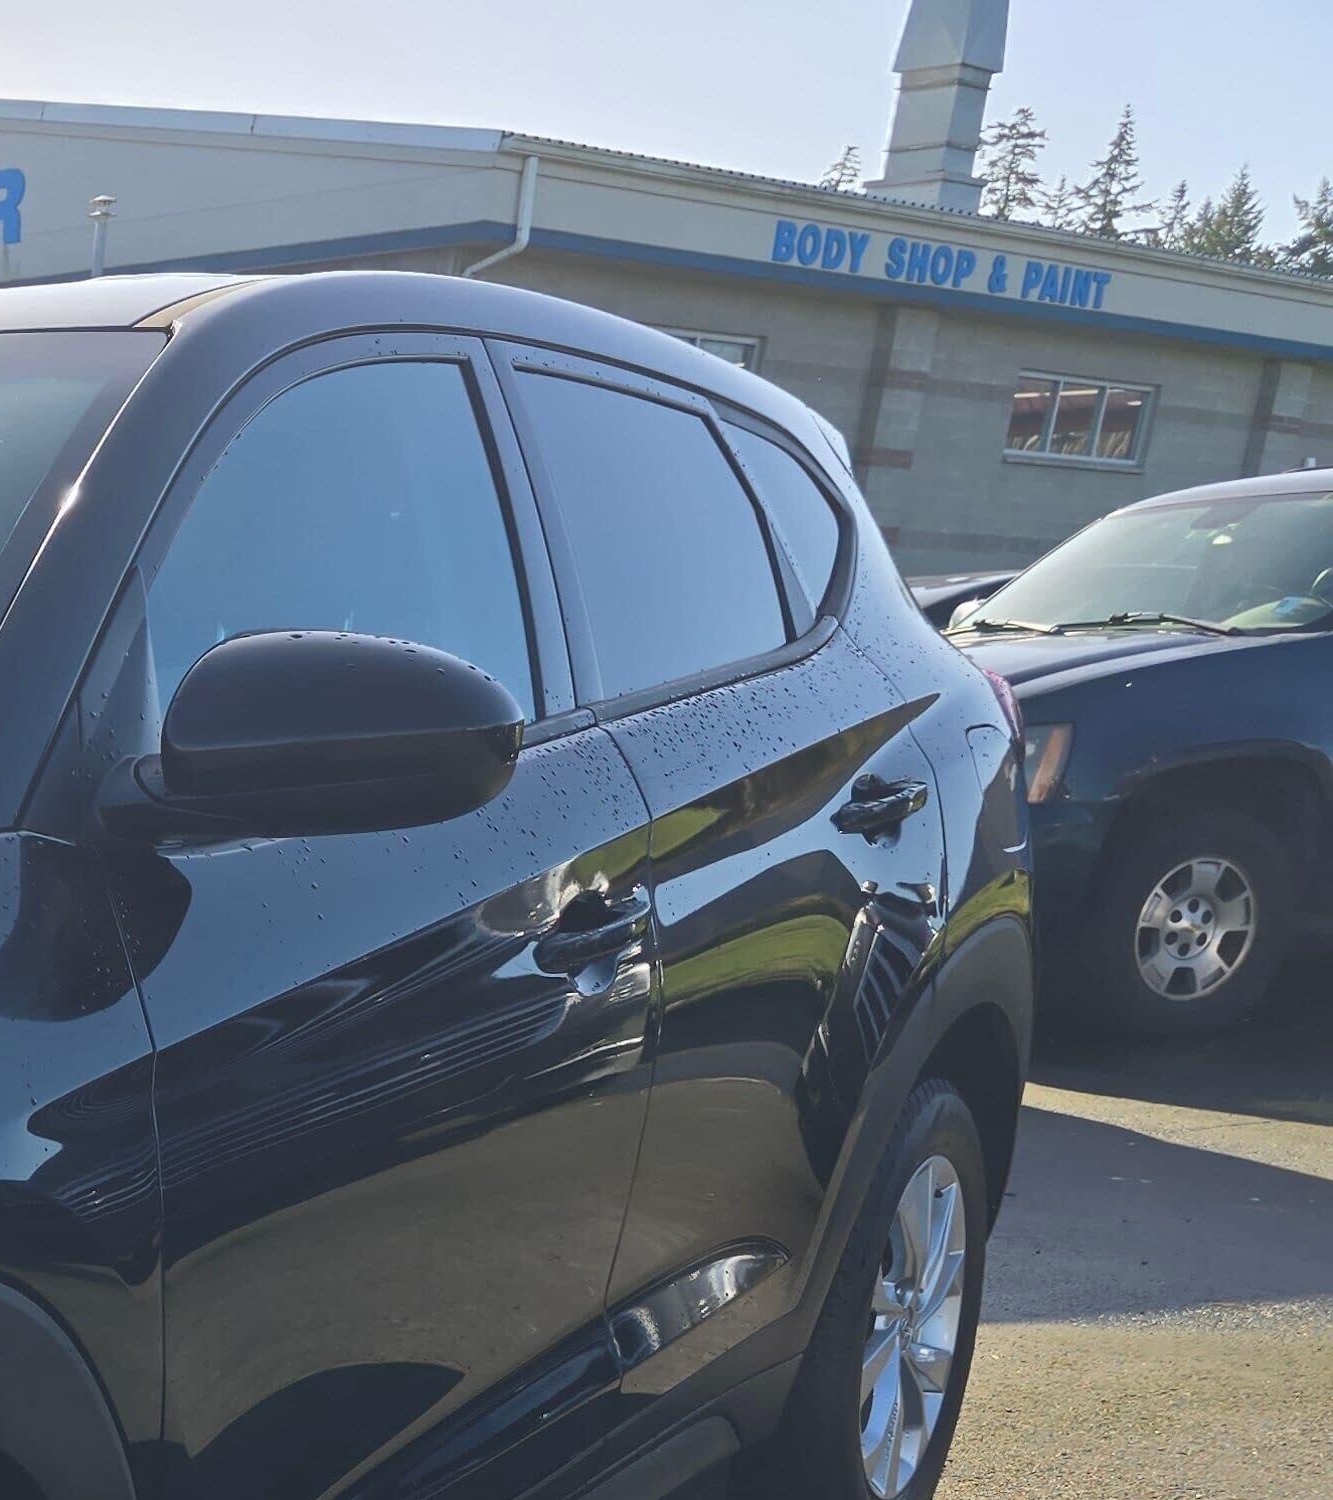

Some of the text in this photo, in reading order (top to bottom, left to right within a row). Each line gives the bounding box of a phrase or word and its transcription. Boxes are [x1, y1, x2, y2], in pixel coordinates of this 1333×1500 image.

[771, 219, 1112, 310] BODY SHOP & PAINT
